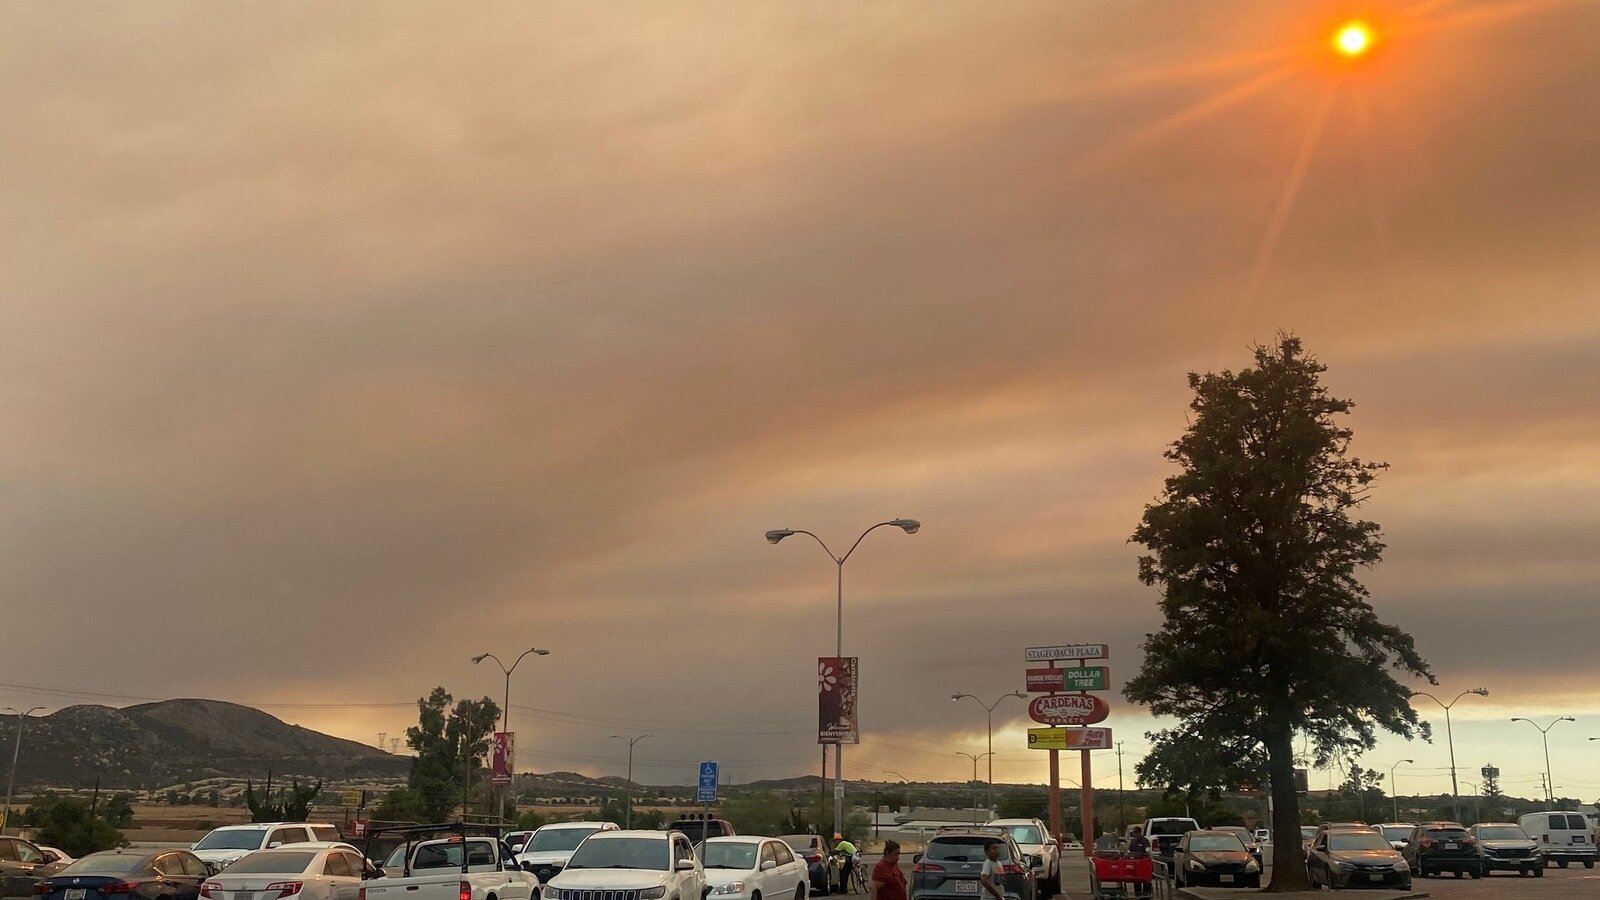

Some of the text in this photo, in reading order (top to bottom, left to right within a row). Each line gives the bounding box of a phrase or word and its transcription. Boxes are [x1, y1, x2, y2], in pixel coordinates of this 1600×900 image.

[1028, 648, 1099, 658] STAGECOACH PLAZA
[1068, 671, 1100, 679] DOLLAR
[1035, 697, 1094, 715] CARDENAS
